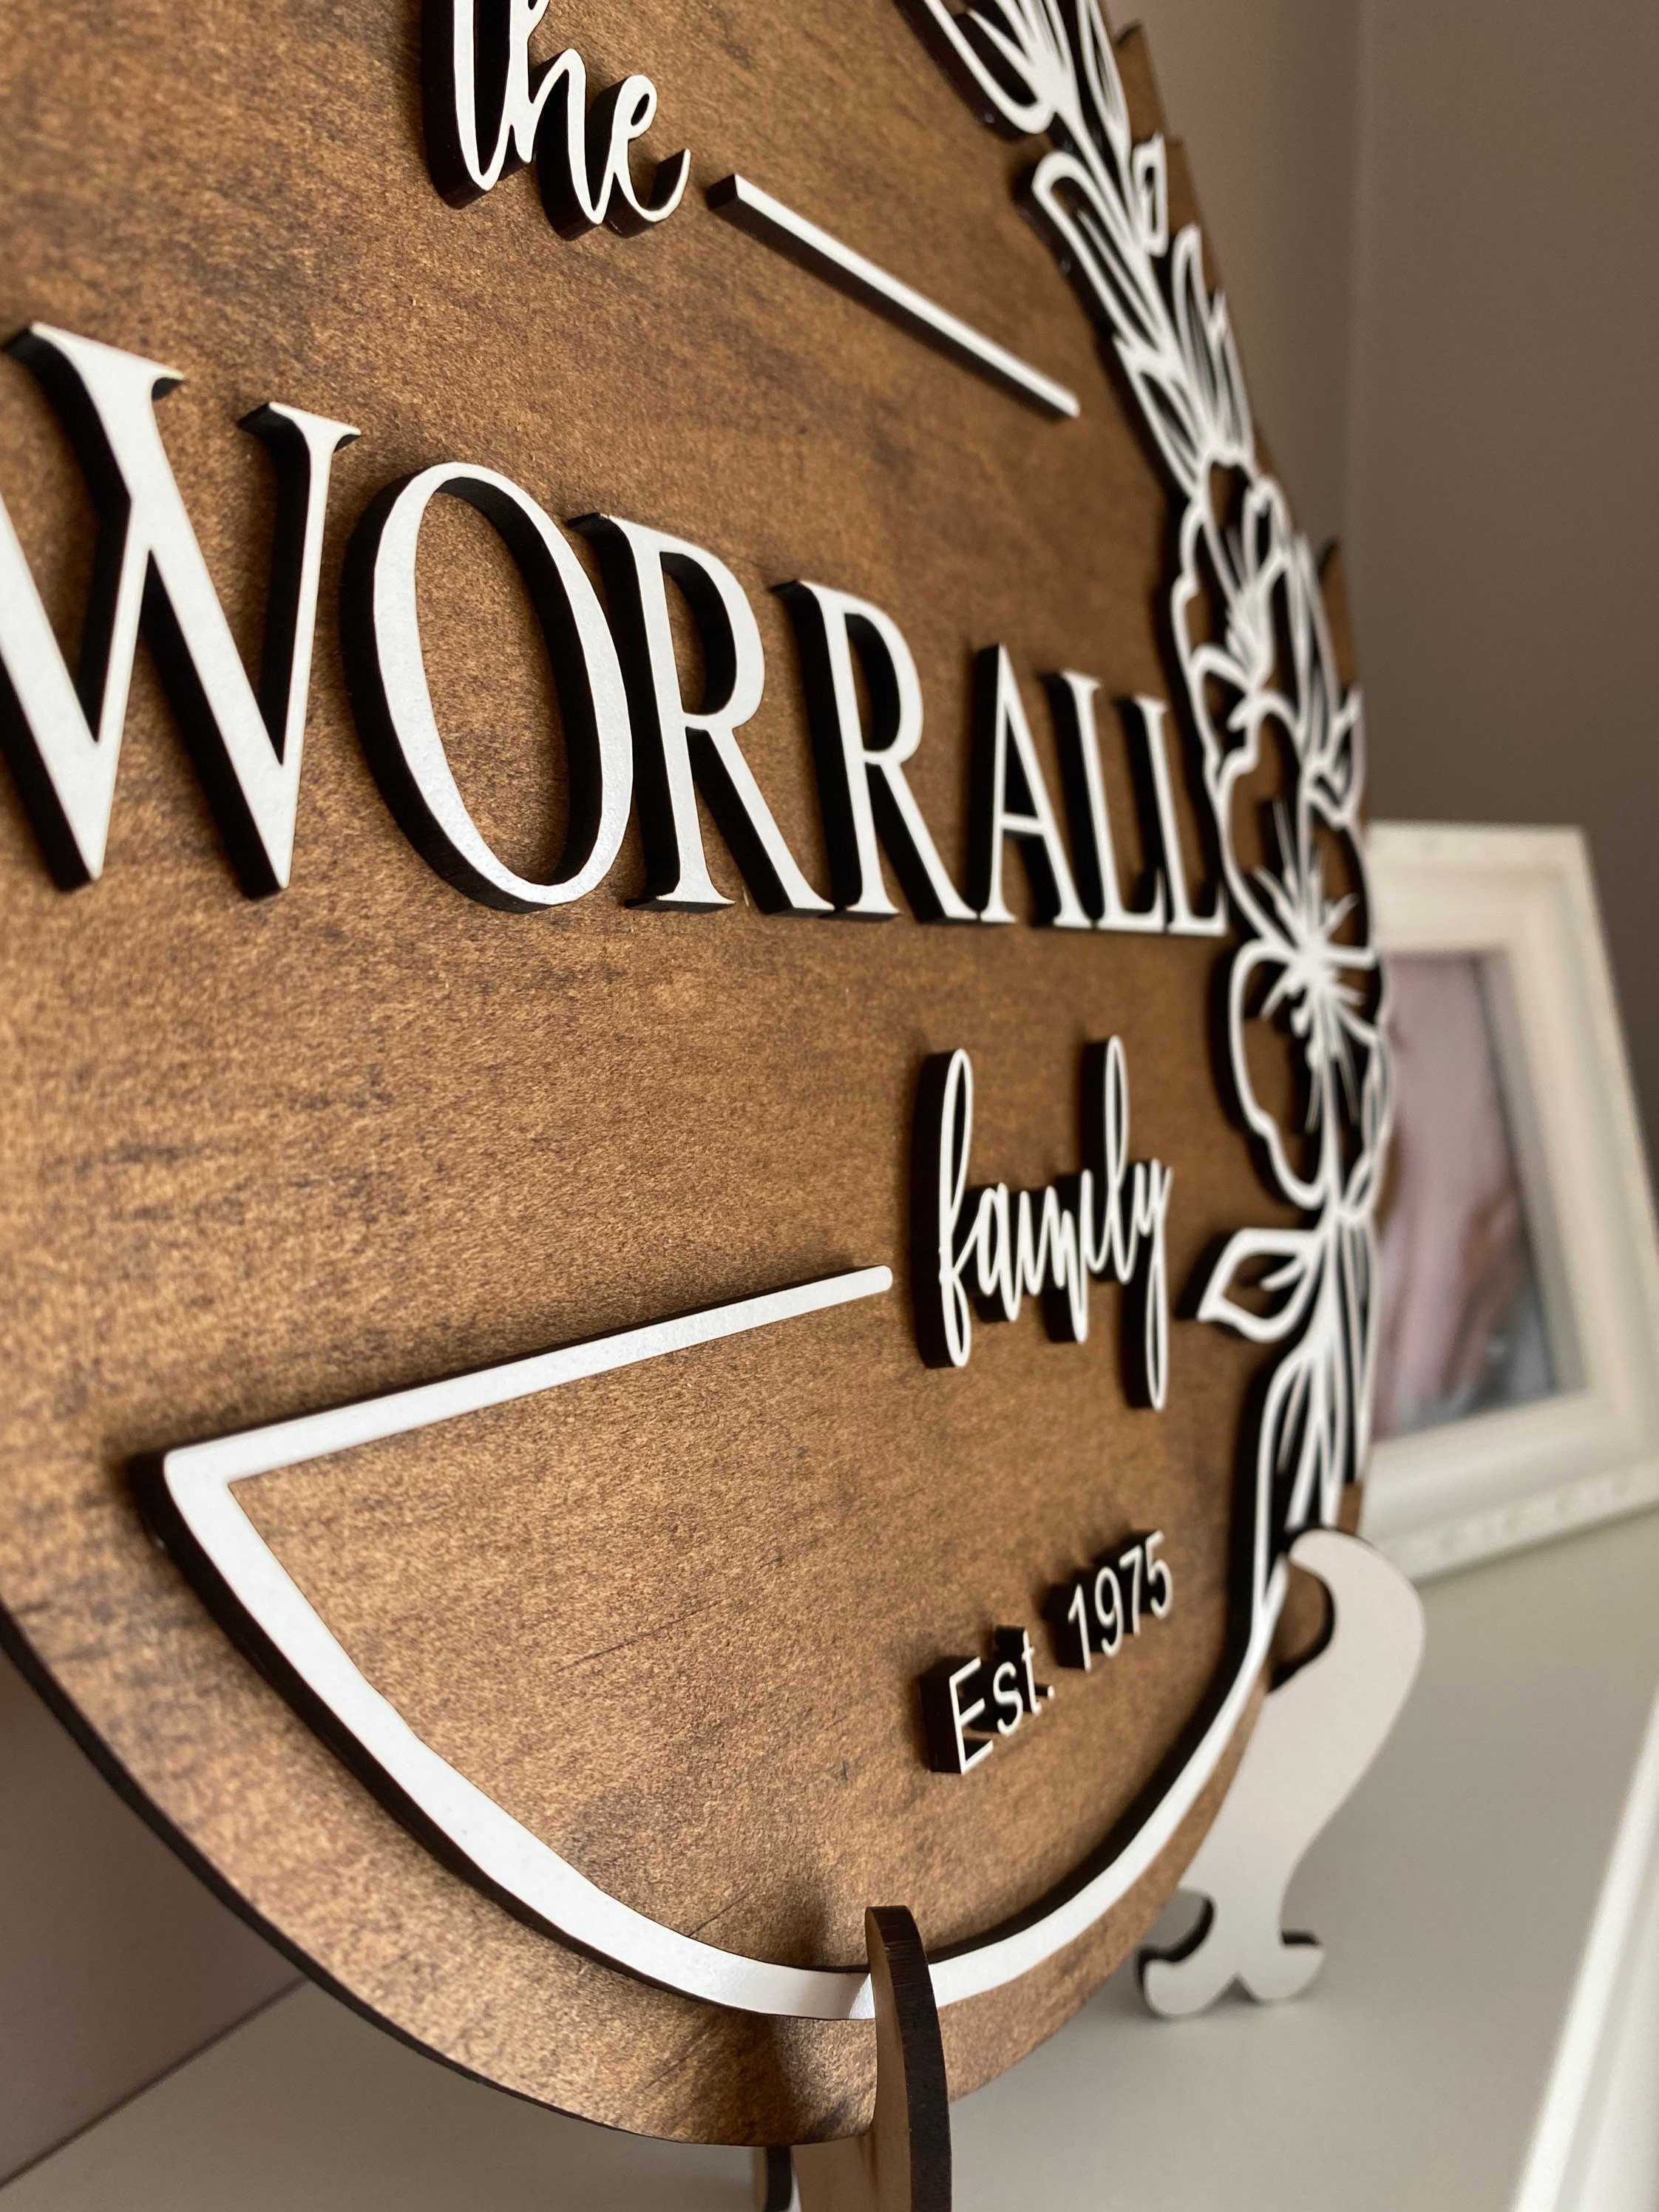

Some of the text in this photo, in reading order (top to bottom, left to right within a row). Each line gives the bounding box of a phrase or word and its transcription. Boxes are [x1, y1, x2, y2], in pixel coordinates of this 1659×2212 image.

[452, 0, 691, 225] the
[0, 322, 1227, 935] WORRALL
[939, 1035, 1174, 1411] family
[949, 1530, 1173, 1775] Est. 1975
